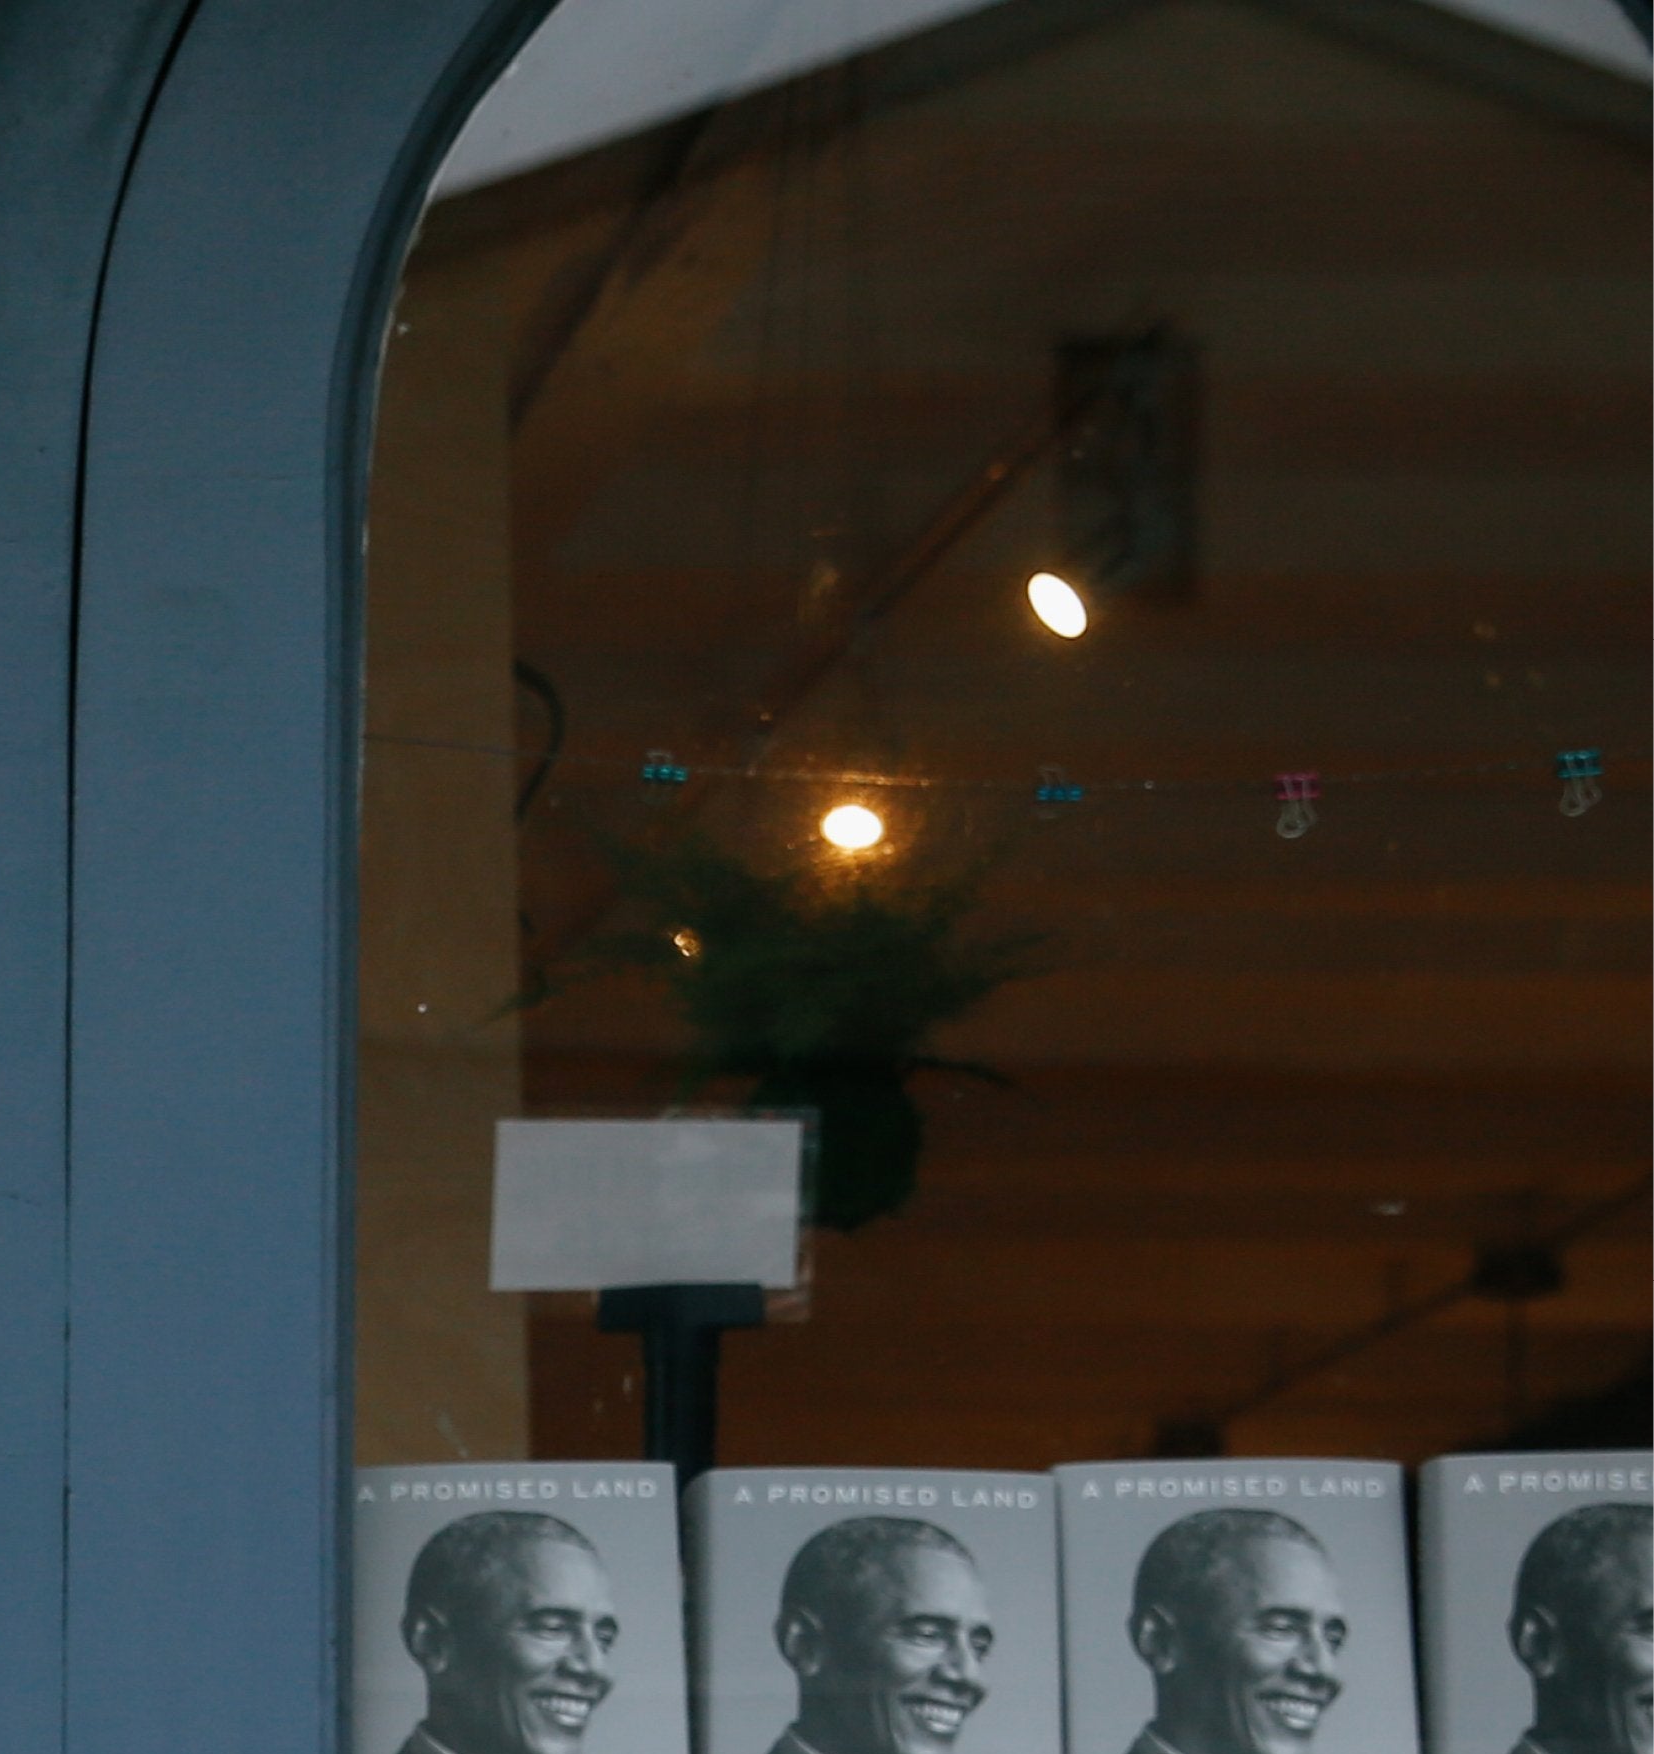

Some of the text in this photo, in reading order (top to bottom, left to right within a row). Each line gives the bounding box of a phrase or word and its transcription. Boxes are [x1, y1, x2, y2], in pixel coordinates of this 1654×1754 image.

[357, 1478, 659, 1503] A PROMISED LAND
[1081, 1476, 1387, 1499] A PROMISED LAND
[1463, 1472, 1486, 1495] A
[734, 1484, 1039, 1510] A PROMISED LAND
